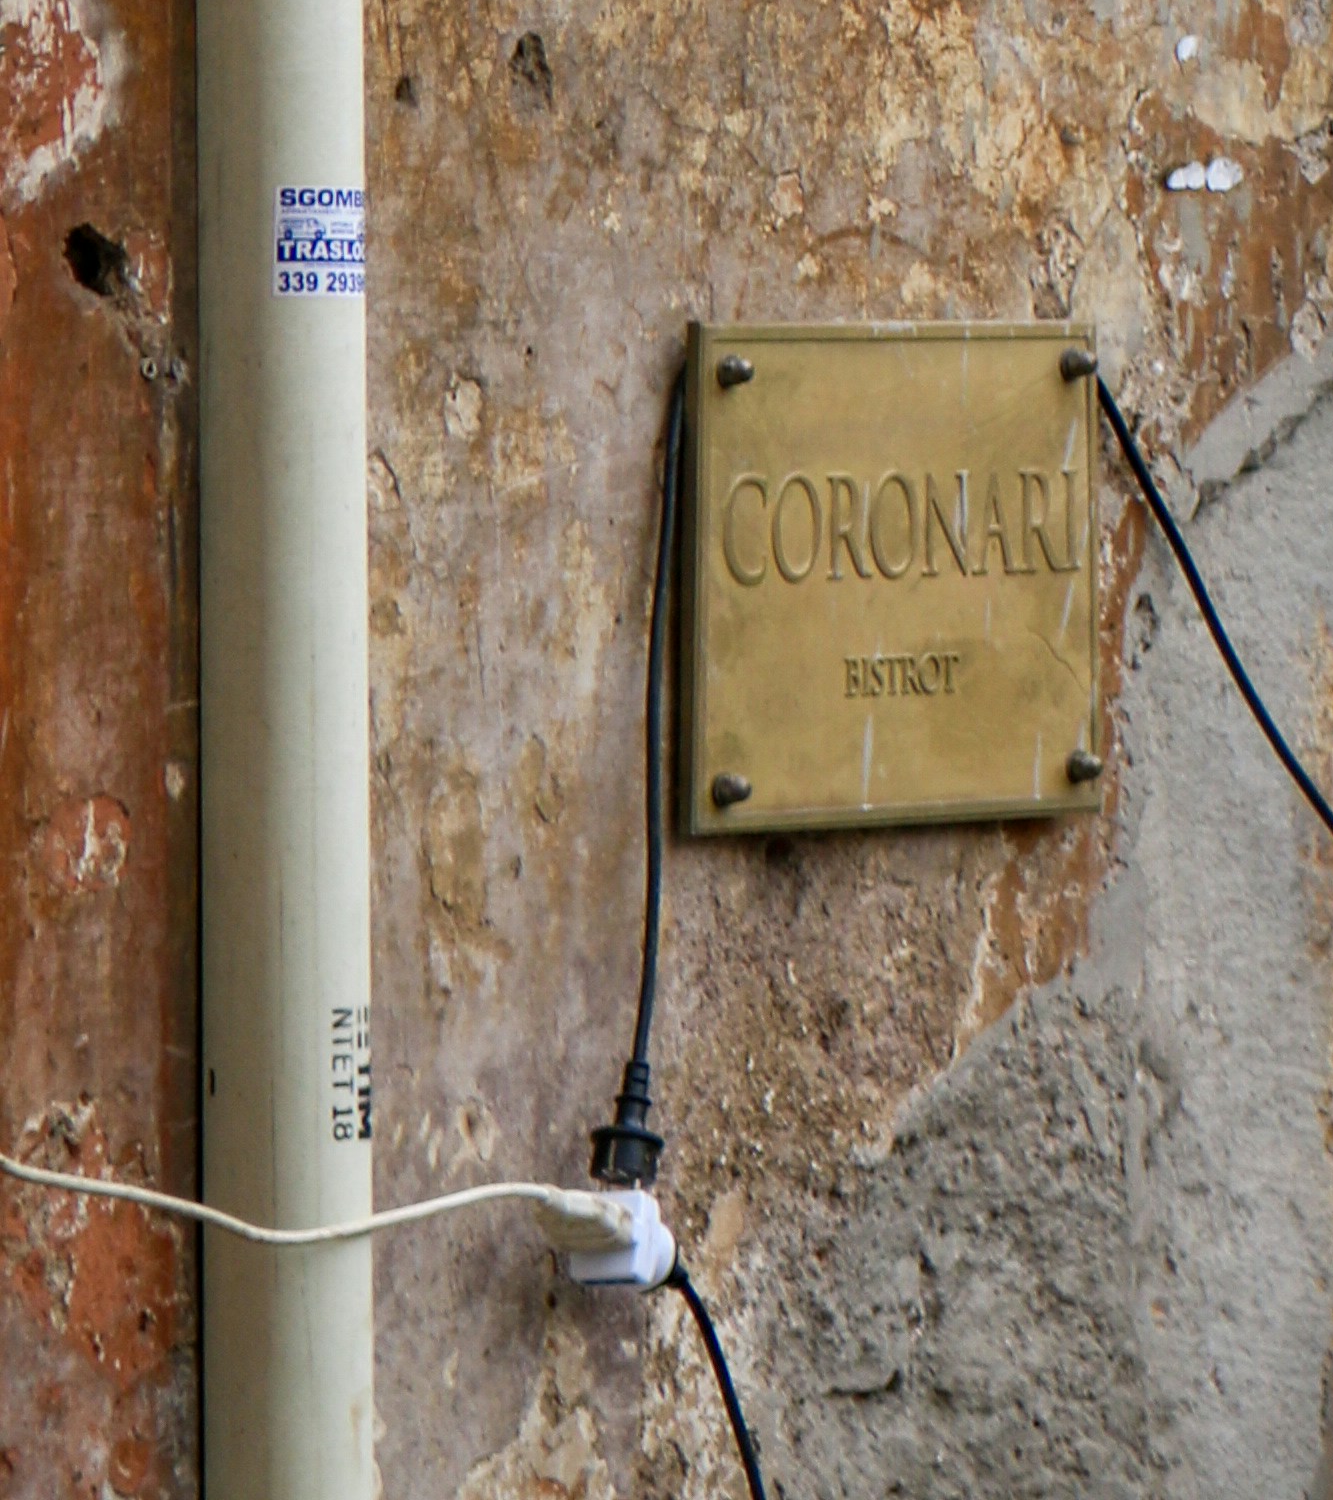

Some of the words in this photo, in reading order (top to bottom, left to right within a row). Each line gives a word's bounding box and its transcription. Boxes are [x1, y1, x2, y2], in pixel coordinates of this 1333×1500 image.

[278, 271, 319, 293] 339
[722, 466, 1081, 586] CORONARI
[844, 652, 960, 698] BISTROT
